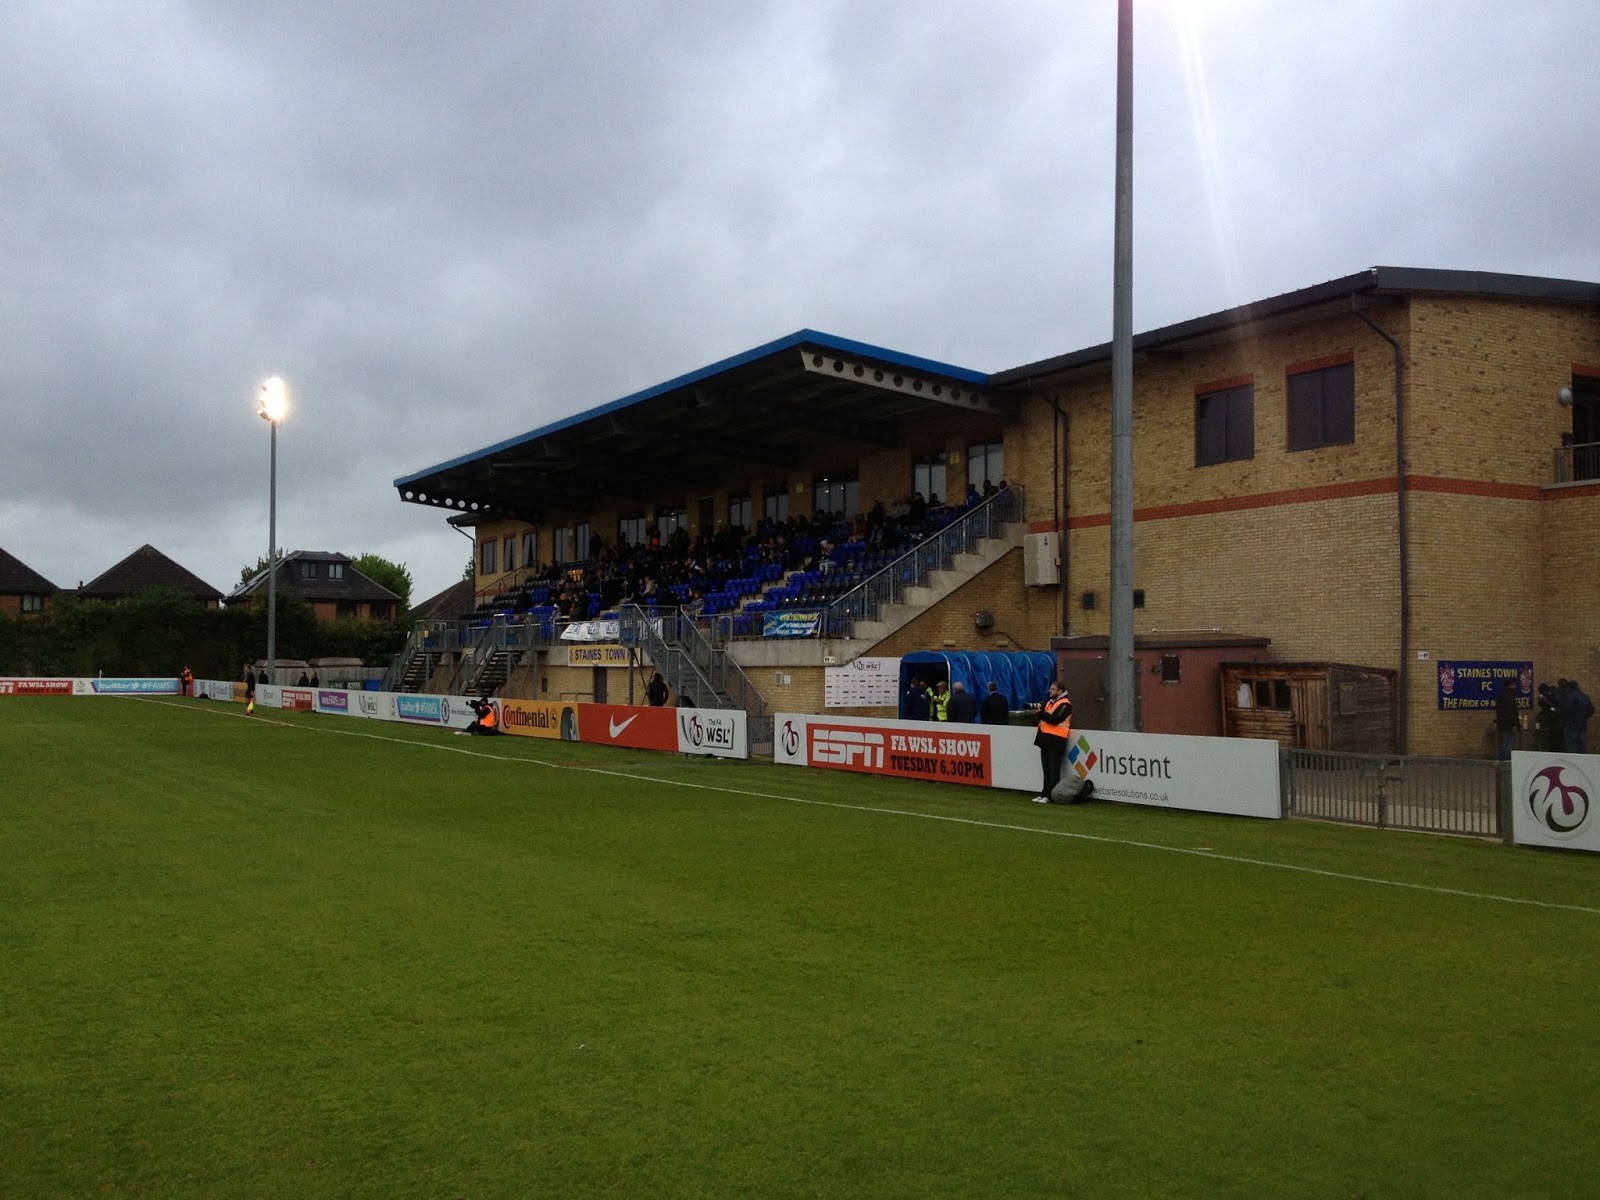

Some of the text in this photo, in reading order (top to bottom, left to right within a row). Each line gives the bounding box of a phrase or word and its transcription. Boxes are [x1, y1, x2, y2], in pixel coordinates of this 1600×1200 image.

[574, 649, 602, 661] STAINES
[605, 648, 626, 661] TOWN
[1457, 668, 1518, 678] STAINES TOWN
[98, 681, 130, 689] twitter
[1481, 681, 1493, 691] FC
[1443, 697, 1457, 709] THE
[1458, 698, 1479, 708] PRIDE
[1480, 699, 1490, 708] OF
[503, 704, 550, 729] Continental
[708, 718, 716, 726] The
[706, 727, 729, 744] WSL
[812, 729, 885, 769] ESPN
[890, 735, 982, 758] FA WSL SHOW
[890, 755, 985, 779] TUESDAY 6.30PM
[1099, 748, 1172, 779] Instant
